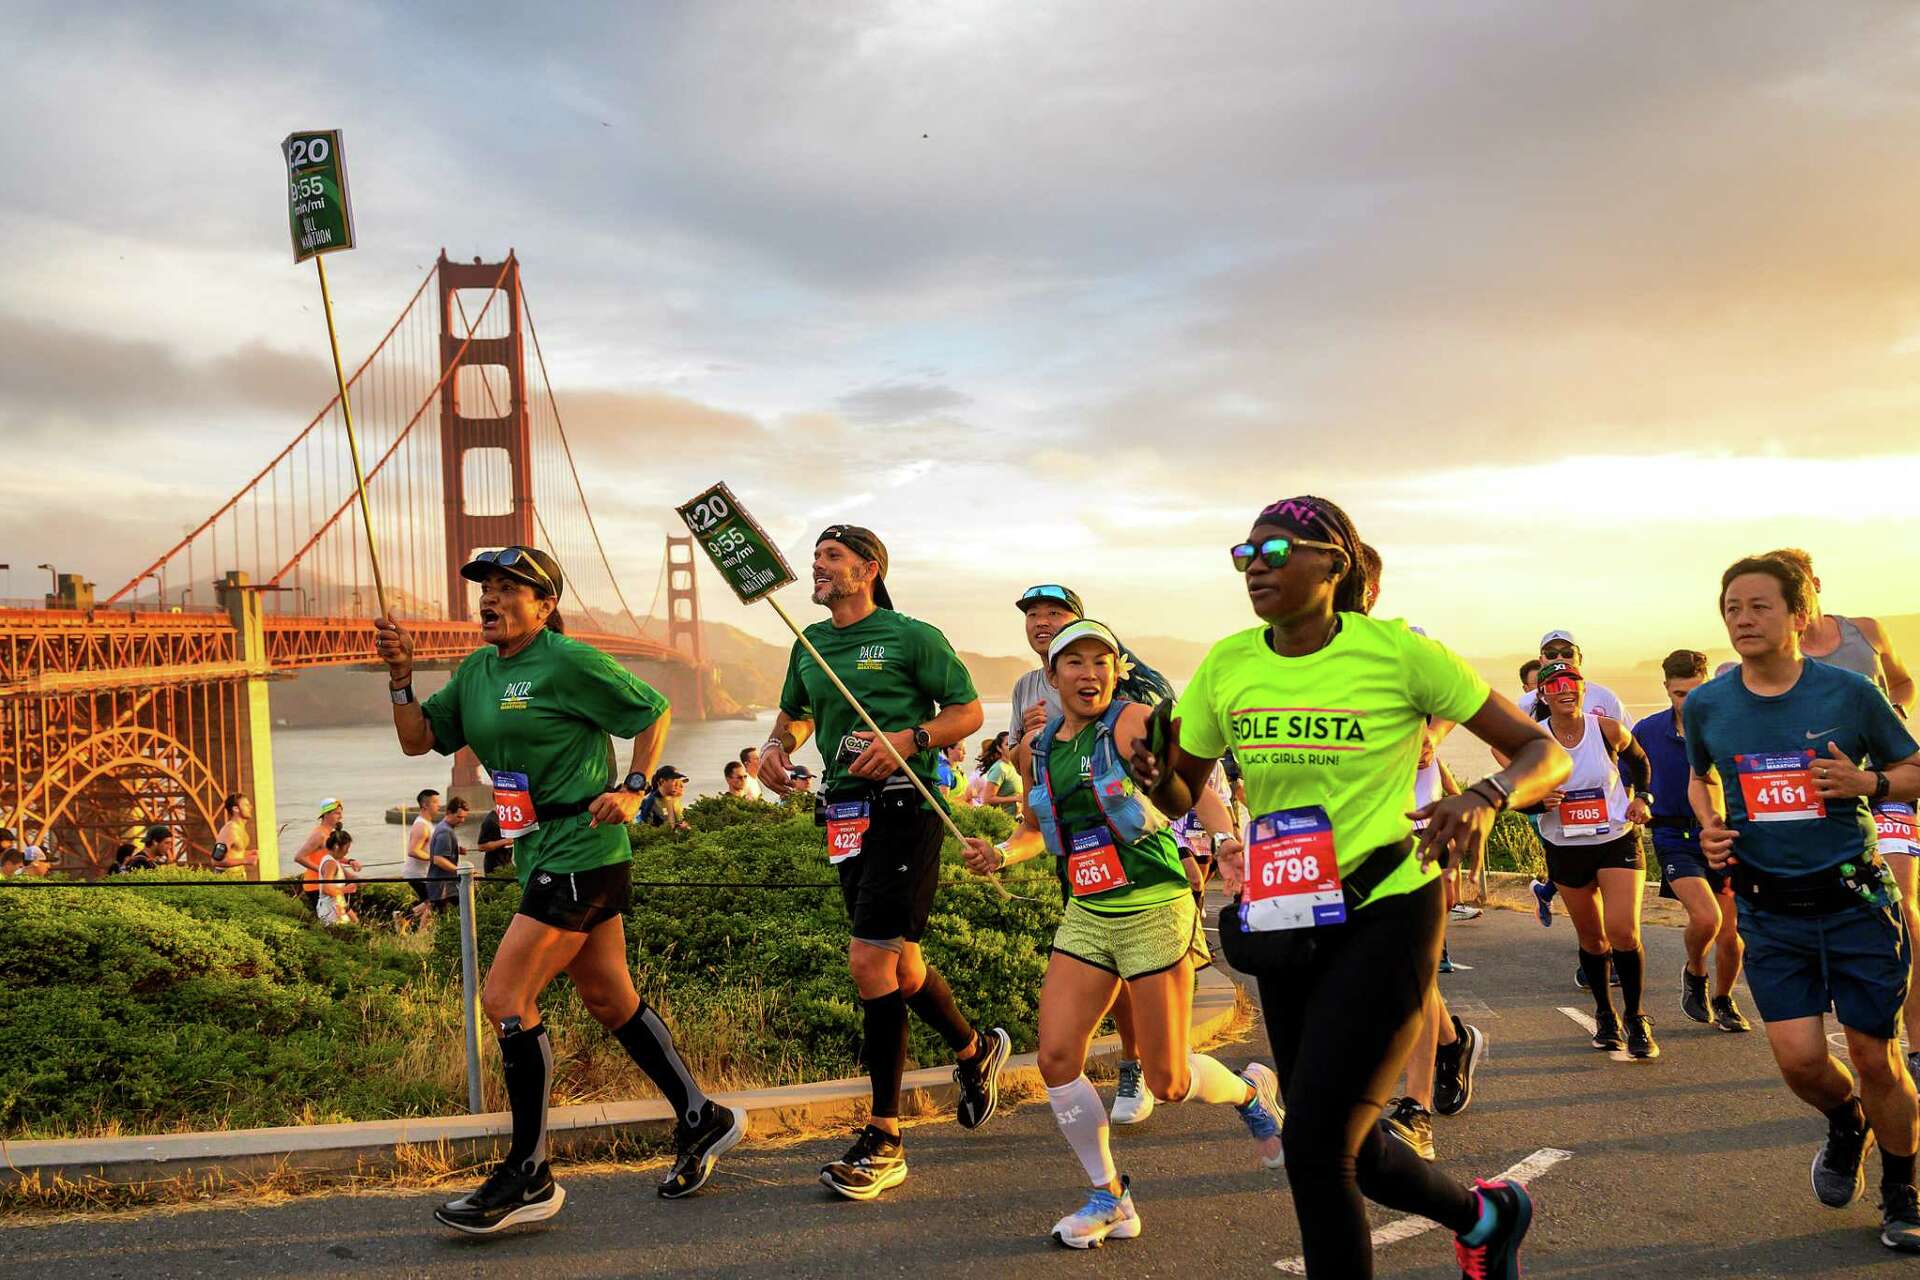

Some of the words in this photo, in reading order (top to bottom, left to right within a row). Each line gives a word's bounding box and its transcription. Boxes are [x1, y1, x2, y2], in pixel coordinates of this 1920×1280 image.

[686, 495, 729, 532] 4:20
[708, 527, 746, 557] 9:55
[722, 544, 755, 569] min/mi
[860, 645, 885, 659] PACER
[503, 681, 532, 697] PACER
[1286, 716, 1365, 741] SISTA
[1243, 753, 1269, 765] LACK
[1271, 753, 1305, 765] GIRLS
[1309, 754, 1340, 765] RUN!
[1757, 785, 1806, 804] 4161
[1569, 808, 1600, 820] 7805
[1075, 863, 1111, 886] 4261
[1262, 855, 1320, 887] 6798
